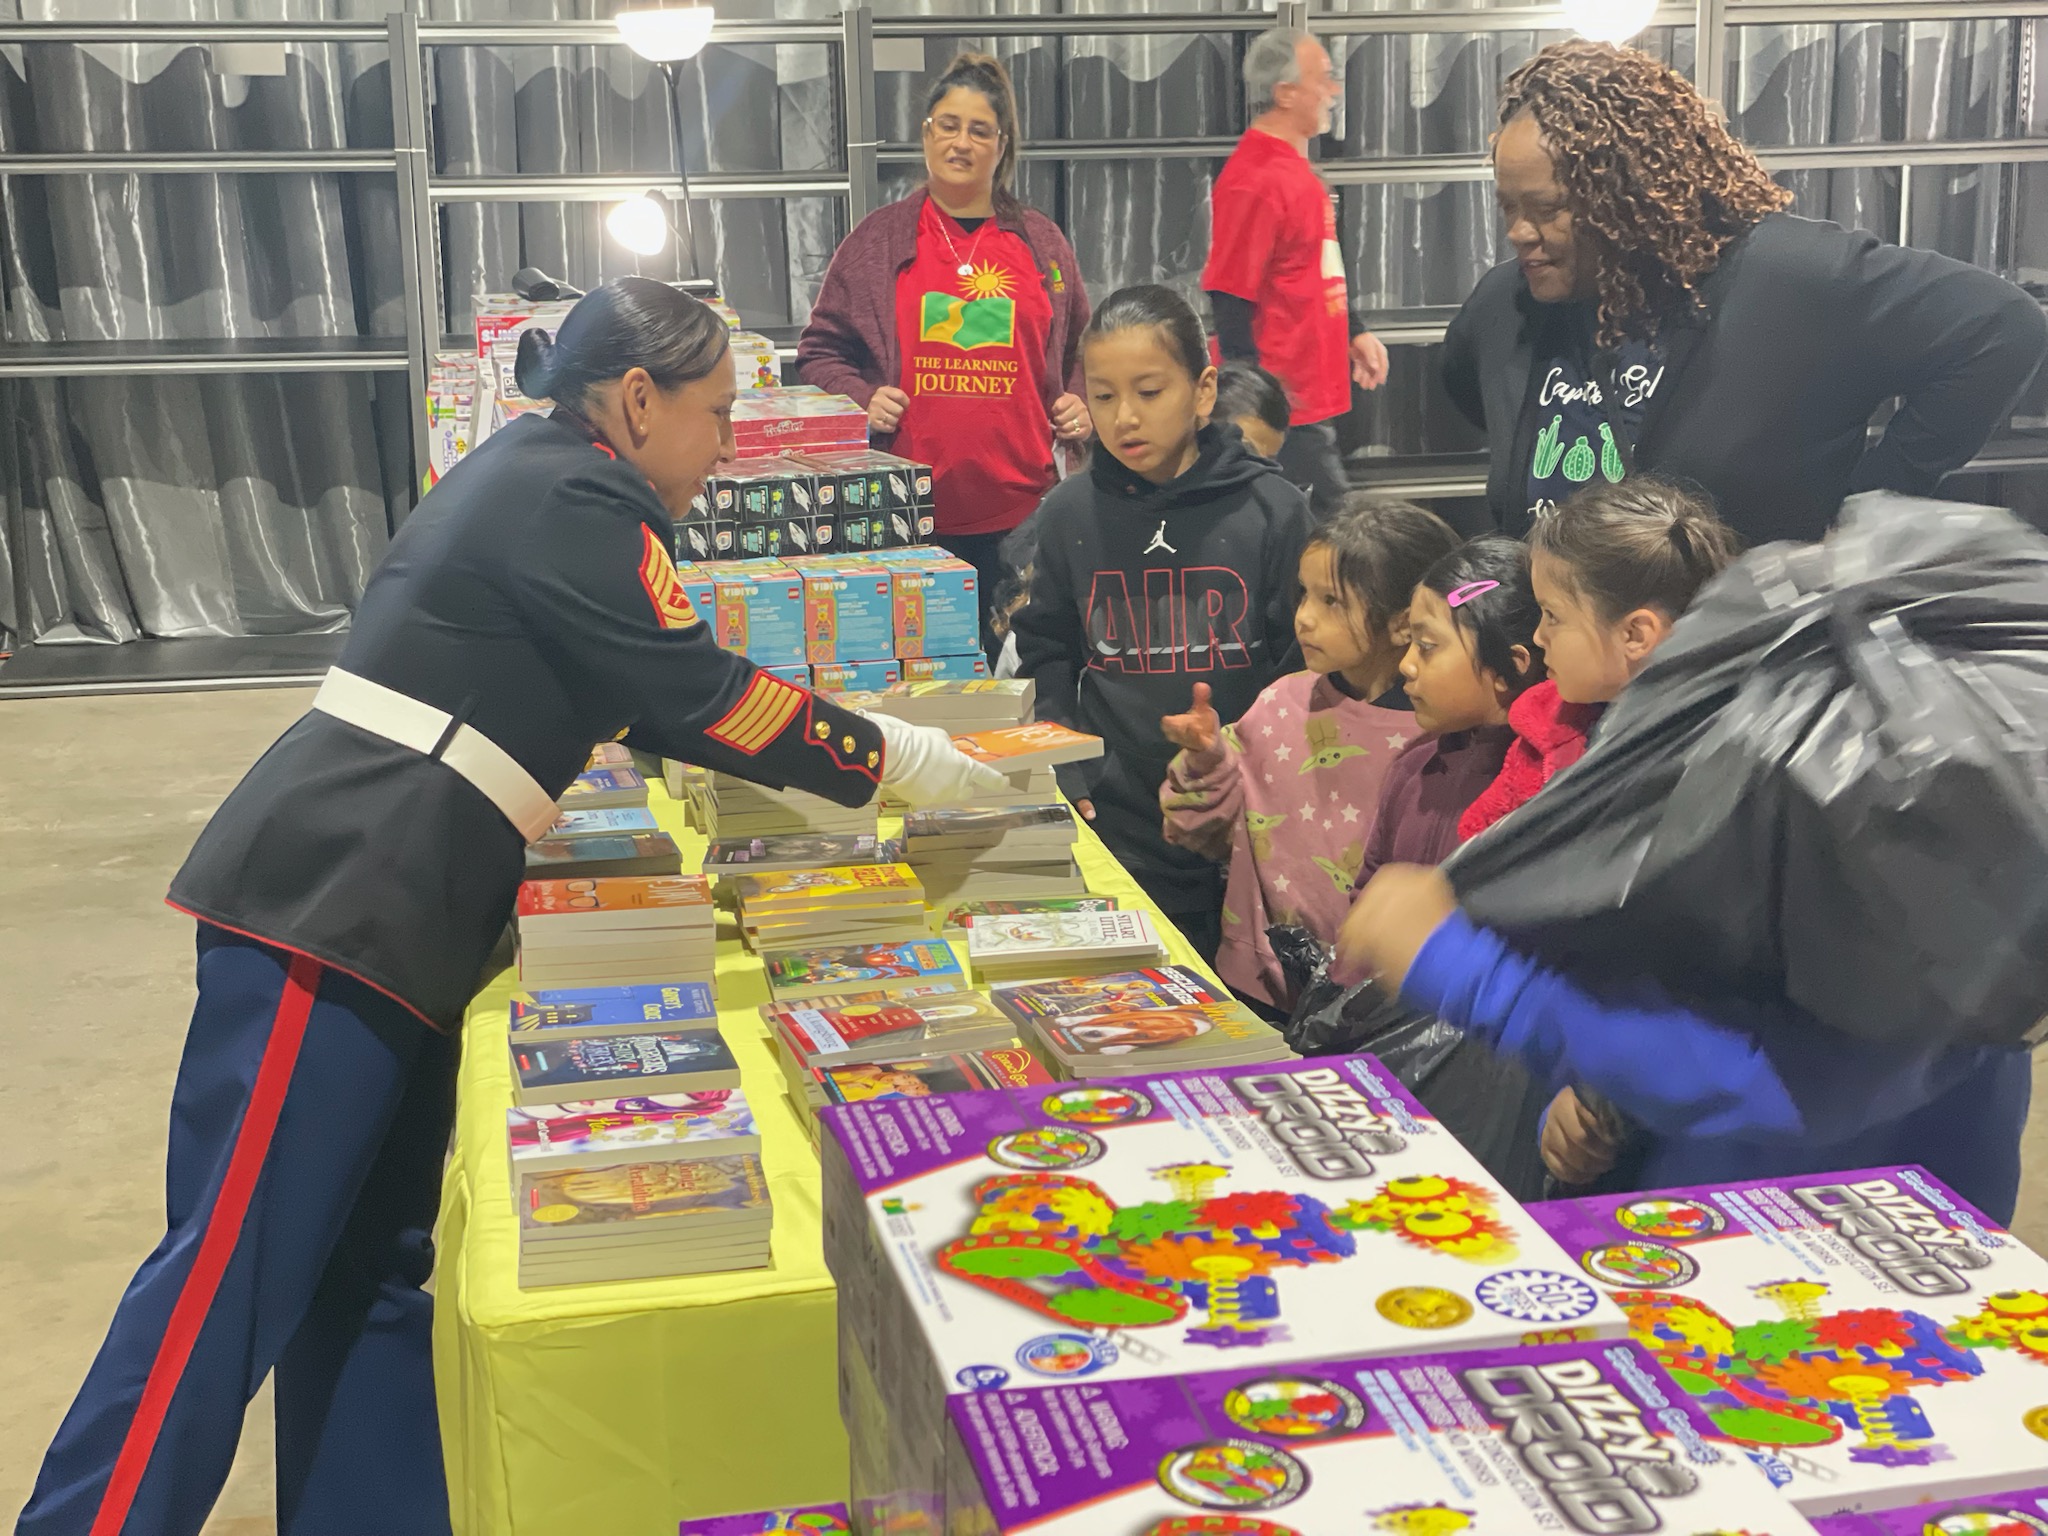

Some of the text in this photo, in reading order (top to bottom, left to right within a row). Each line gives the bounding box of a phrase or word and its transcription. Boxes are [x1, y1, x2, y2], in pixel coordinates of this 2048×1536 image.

[914, 357, 1018, 372] THE LEARNING
[914, 373, 1017, 396] JOURNEY
[1087, 565, 1251, 673] AIR
[1099, 916, 1118, 939] LITTLE
[1116, 914, 1136, 939] STUART
[1154, 967, 1206, 995] RESCUE
[1160, 983, 1200, 1005] DOGS
[1290, 1068, 1388, 1132] DIZZY
[1232, 1073, 1378, 1181] DROID
[1278, 1165, 1300, 1177] SET
[1848, 1179, 1966, 1249] DIZZY
[1794, 1183, 1972, 1296] DROID
[1871, 1281, 1899, 1294] SET
[1536, 1358, 1674, 1464] DIZZY
[1463, 1364, 1663, 1534] DROID
[1534, 1511, 1566, 1530] SET
